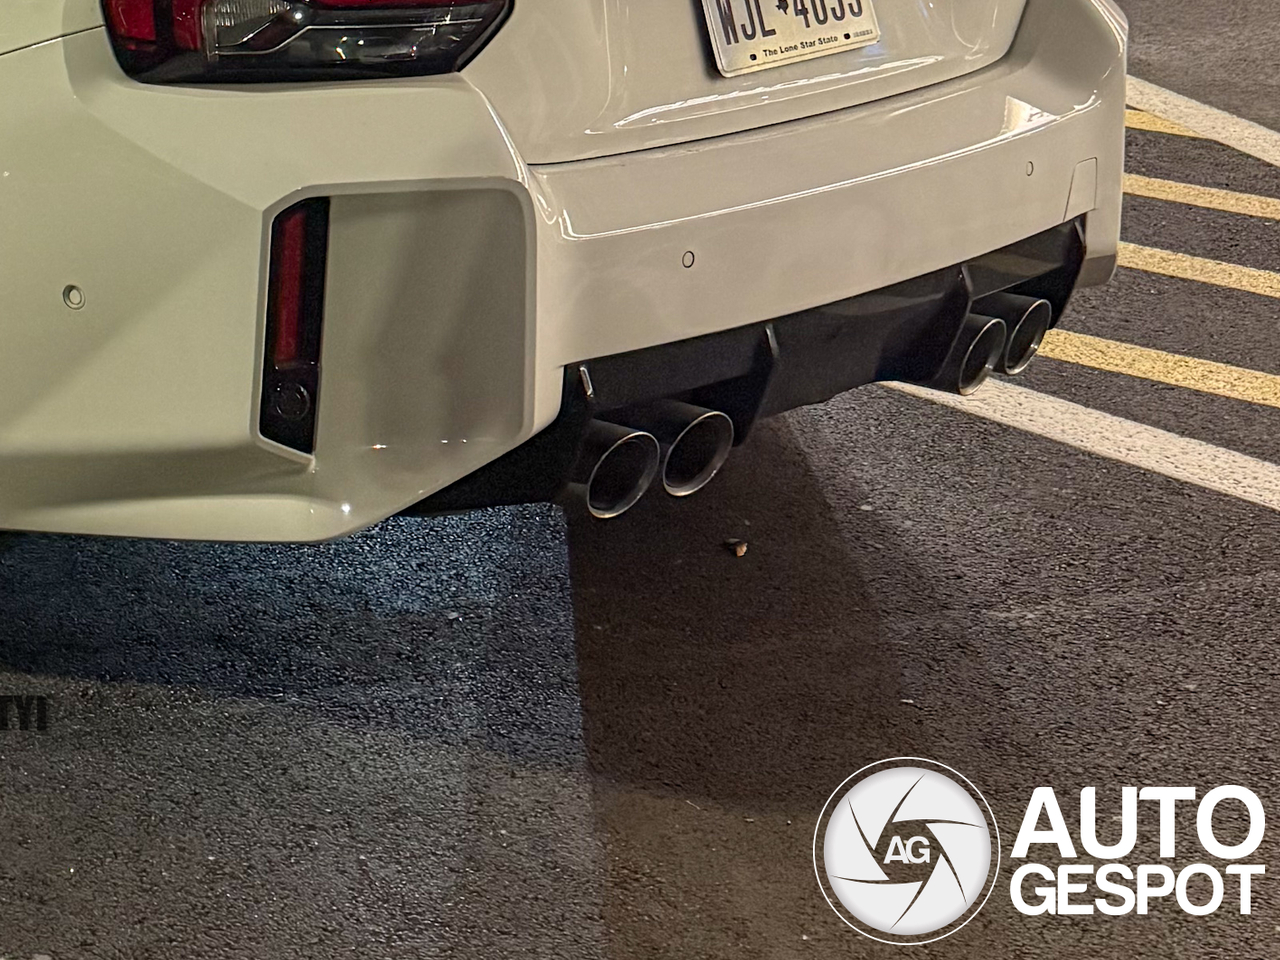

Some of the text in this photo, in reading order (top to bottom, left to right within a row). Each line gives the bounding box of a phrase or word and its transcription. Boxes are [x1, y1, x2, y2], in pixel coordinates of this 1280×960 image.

[762, 48, 778, 58] The
[779, 43, 799, 54] Lone
[800, 38, 816, 50] Star
